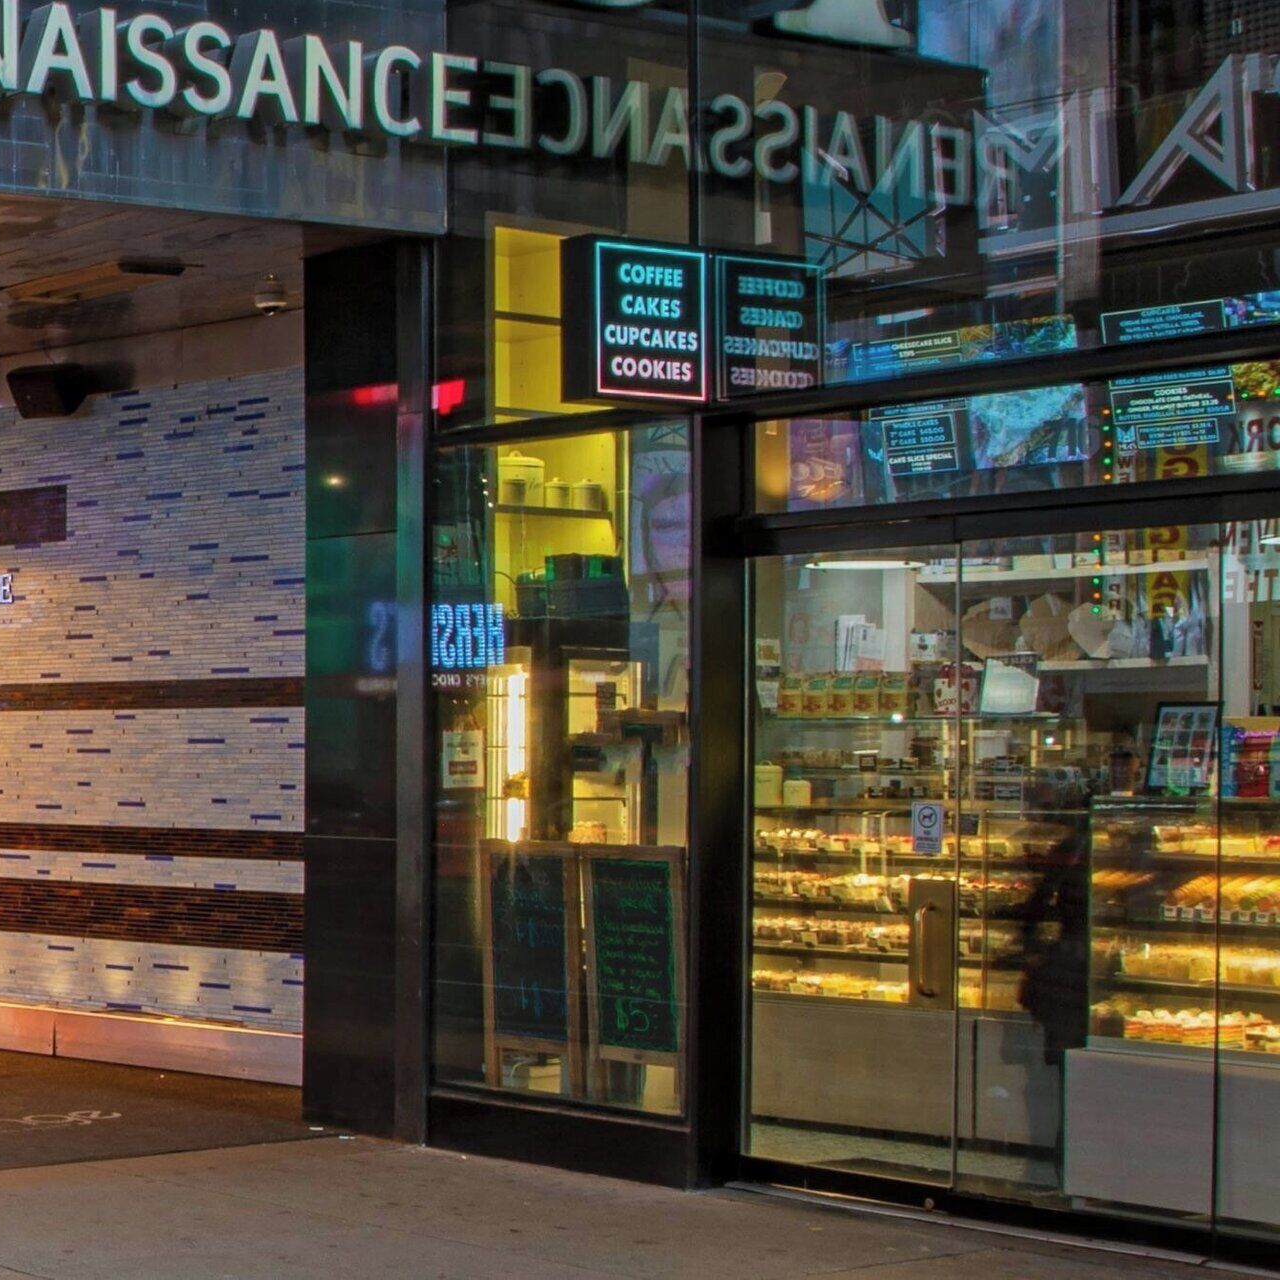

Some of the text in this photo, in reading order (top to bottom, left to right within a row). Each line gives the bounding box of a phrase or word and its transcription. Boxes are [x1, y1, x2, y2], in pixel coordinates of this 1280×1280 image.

[619, 262, 683, 289] COFFEE
[621, 294, 681, 318] CAKES
[604, 324, 698, 351] CUPCAKES
[611, 356, 691, 383] COOKIES
